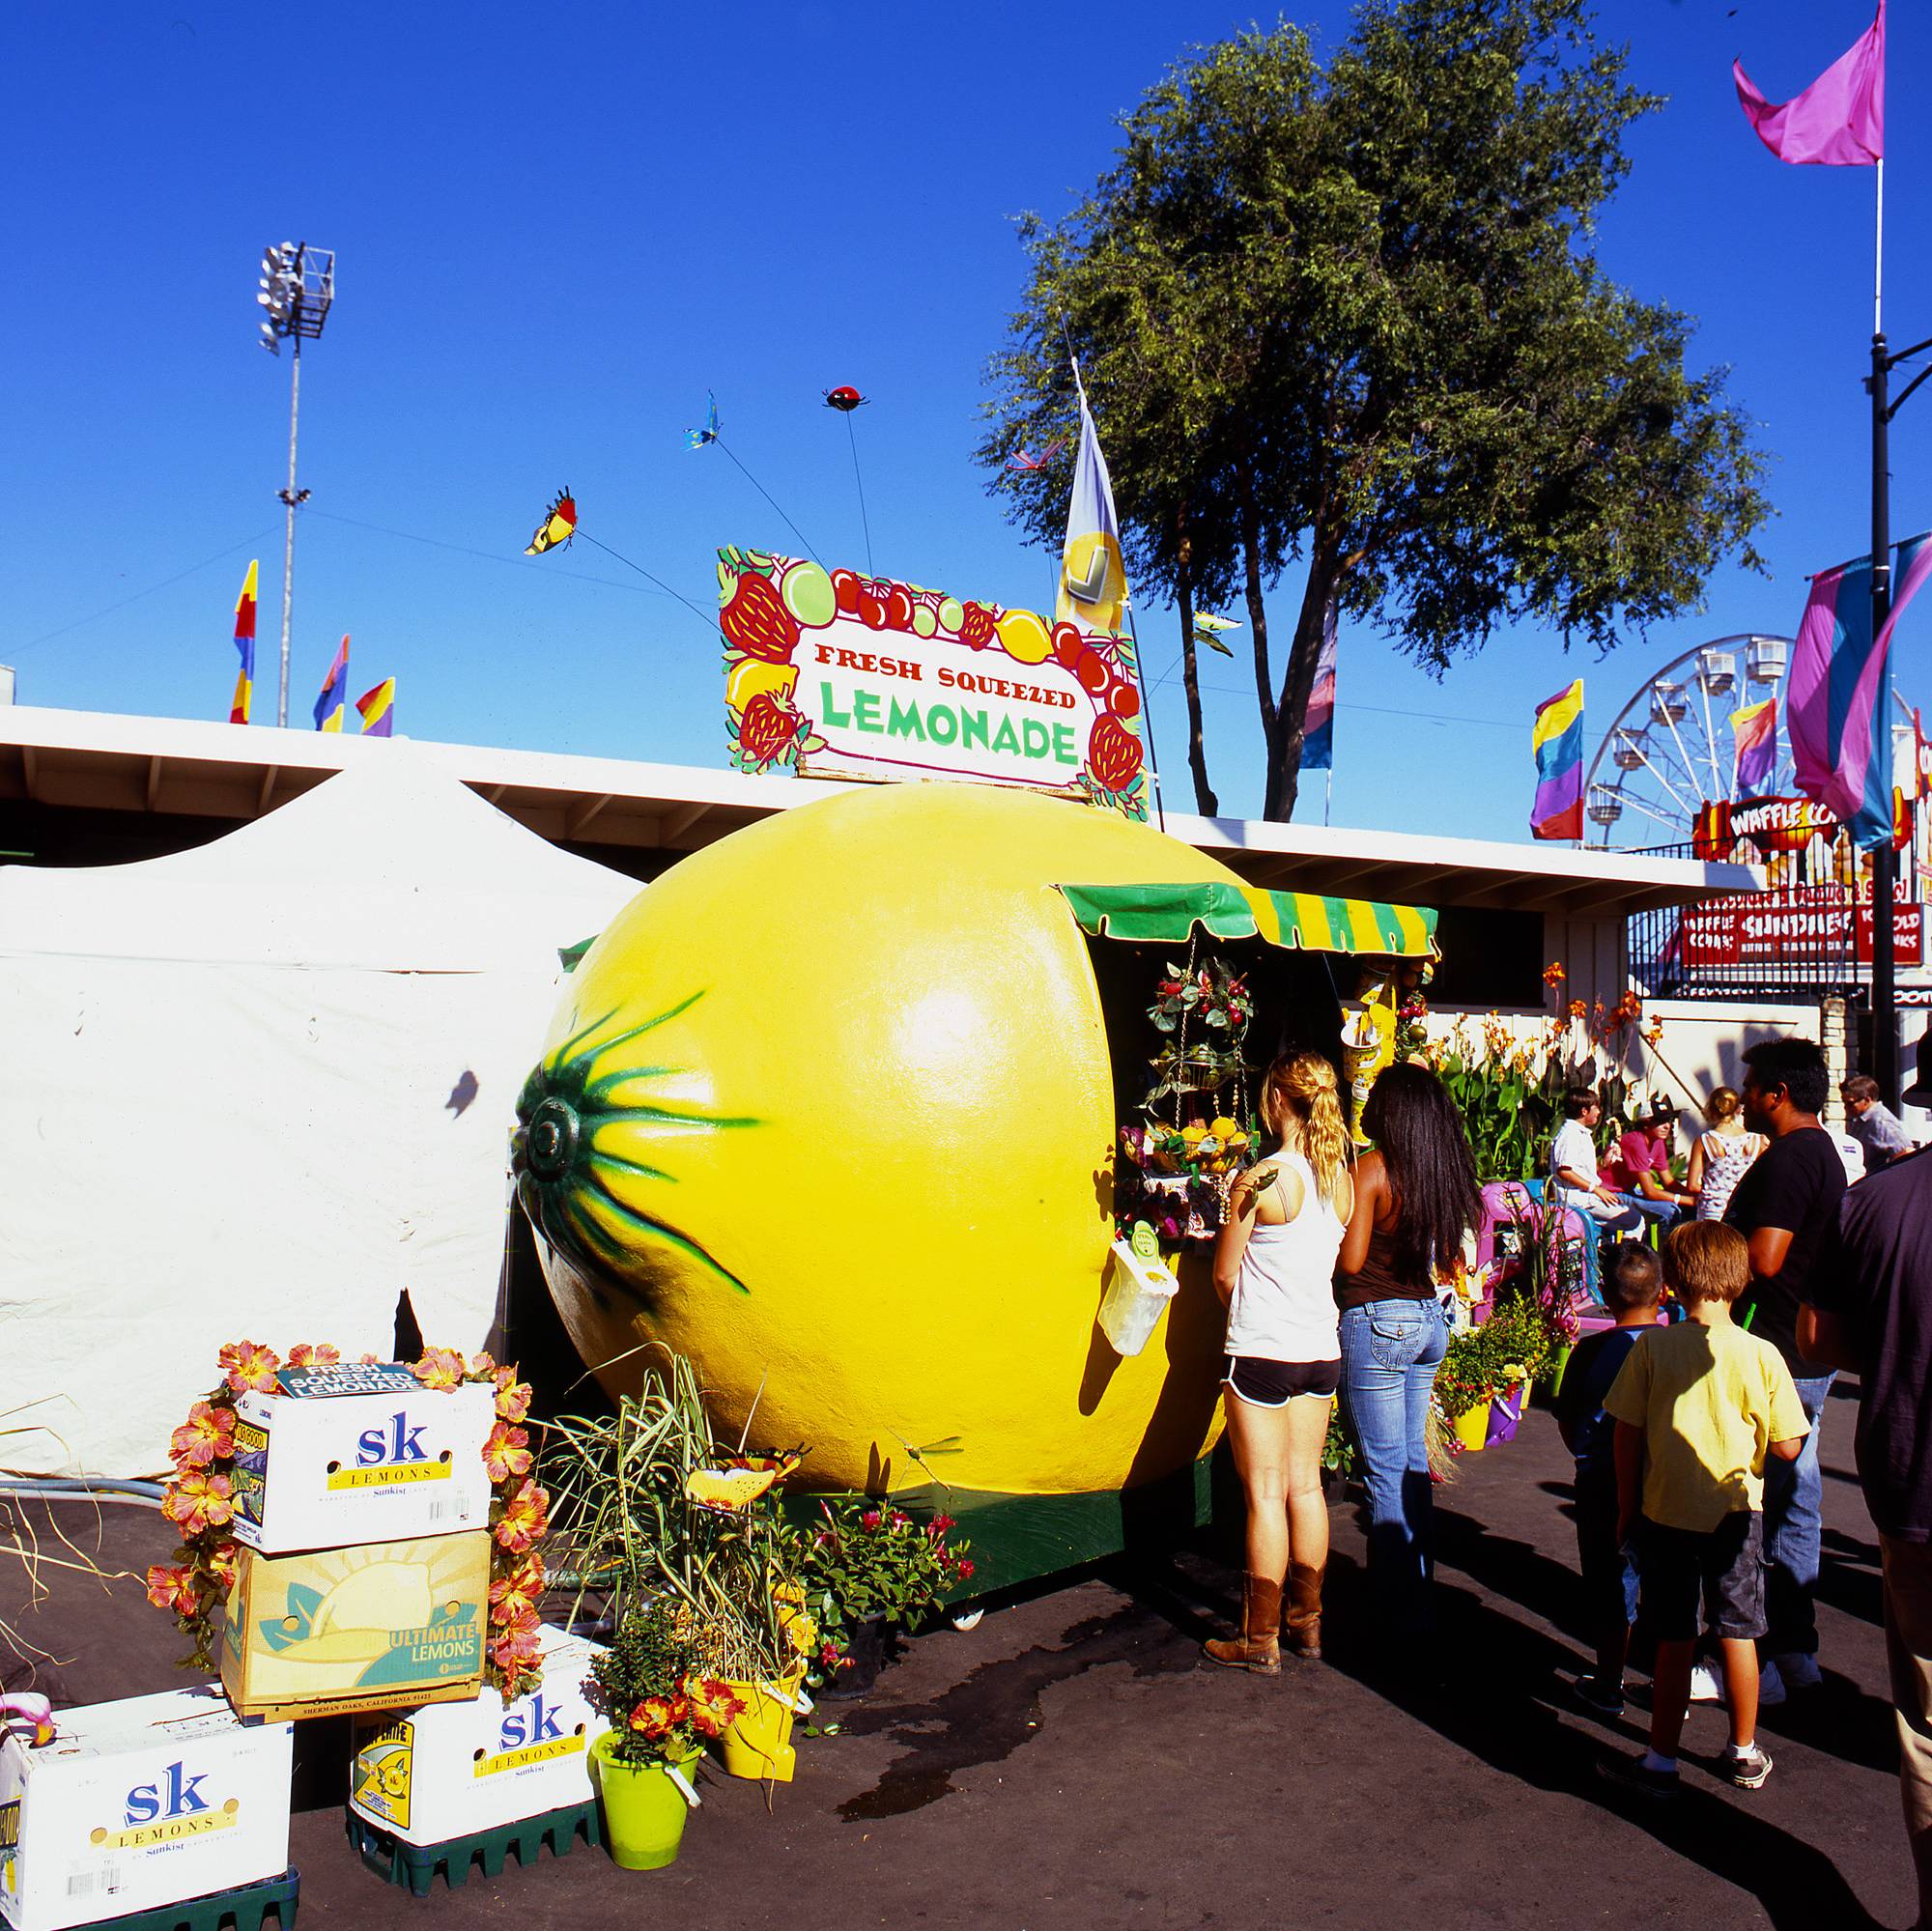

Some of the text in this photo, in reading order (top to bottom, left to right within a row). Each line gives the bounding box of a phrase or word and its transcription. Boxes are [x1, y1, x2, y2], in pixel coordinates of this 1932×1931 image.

[814, 643, 1076, 709] FRESH SQUEEZED
[820, 681, 1080, 766] LEMONADE
[1730, 801, 1803, 837] WAFFLE
[1892, 913, 1919, 931] OLD
[290, 1372, 412, 1388] SQUEEZED
[305, 1363, 382, 1376] FRESH
[294, 1381, 423, 1398] LEMONADE
[356, 1410, 428, 1467] sk
[351, 1468, 433, 1486] LEMONS
[373, 1486, 407, 1498] Sunkist
[390, 1623, 475, 1649] ULTIMATE
[412, 1640, 474, 1662] LEMONS
[303, 1705, 339, 1715] SHERMAN
[366, 1696, 411, 1707] CALIFORNIA
[497, 1692, 564, 1752] sk
[495, 1745, 567, 1770] LEMONS
[515, 1765, 545, 1777] Sunkist
[124, 1760, 210, 1828] sk
[119, 1817, 214, 1848] LEMONS
[147, 1842, 185, 1857] Sunkist
